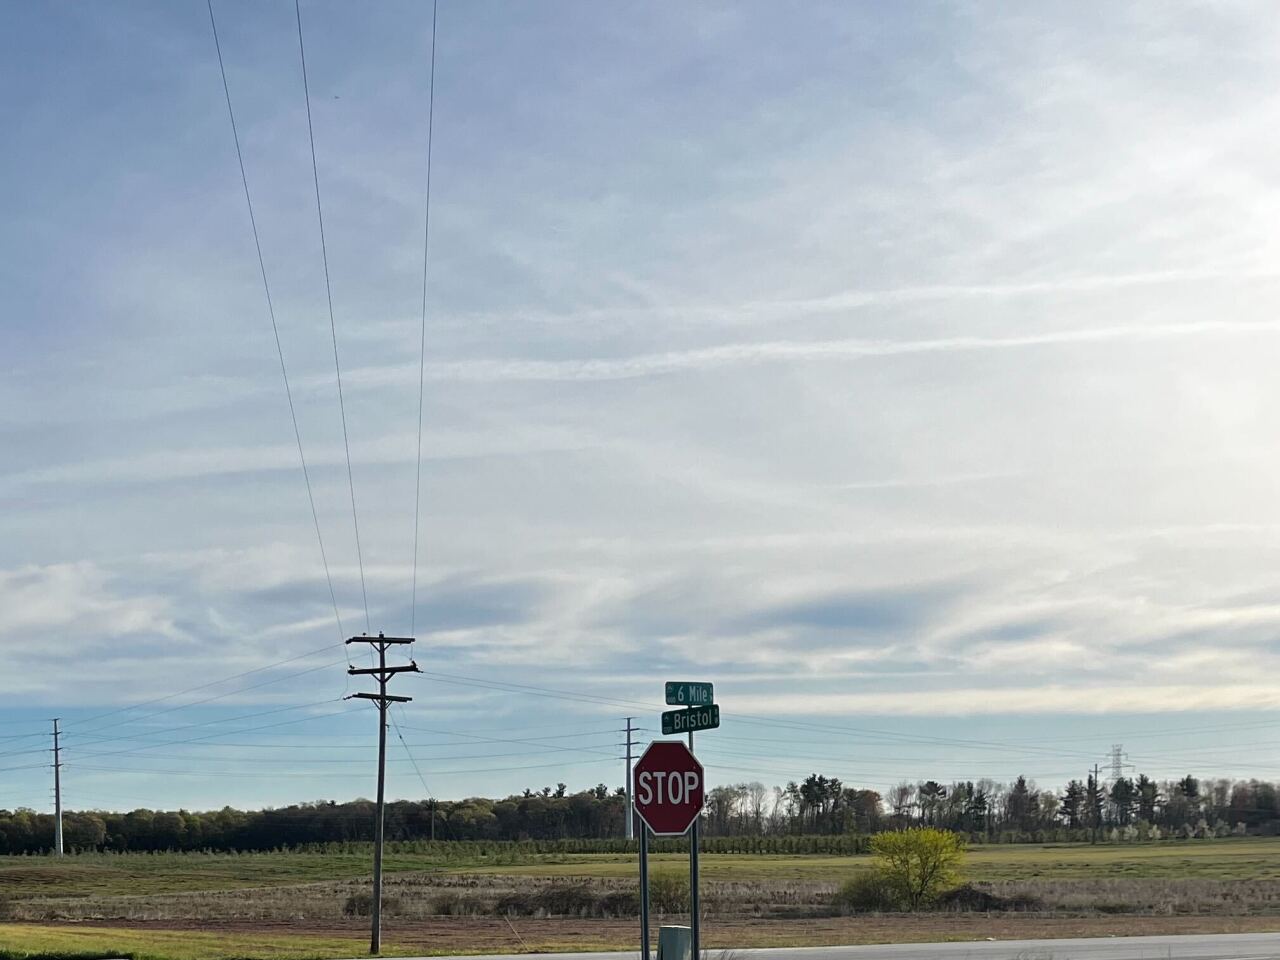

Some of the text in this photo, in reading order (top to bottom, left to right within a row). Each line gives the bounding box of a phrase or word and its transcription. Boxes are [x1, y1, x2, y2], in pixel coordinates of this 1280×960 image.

[677, 685, 685, 702] 6
[689, 685, 708, 702] Mile
[673, 709, 712, 730] Bristol
[638, 770, 699, 805] STOP
